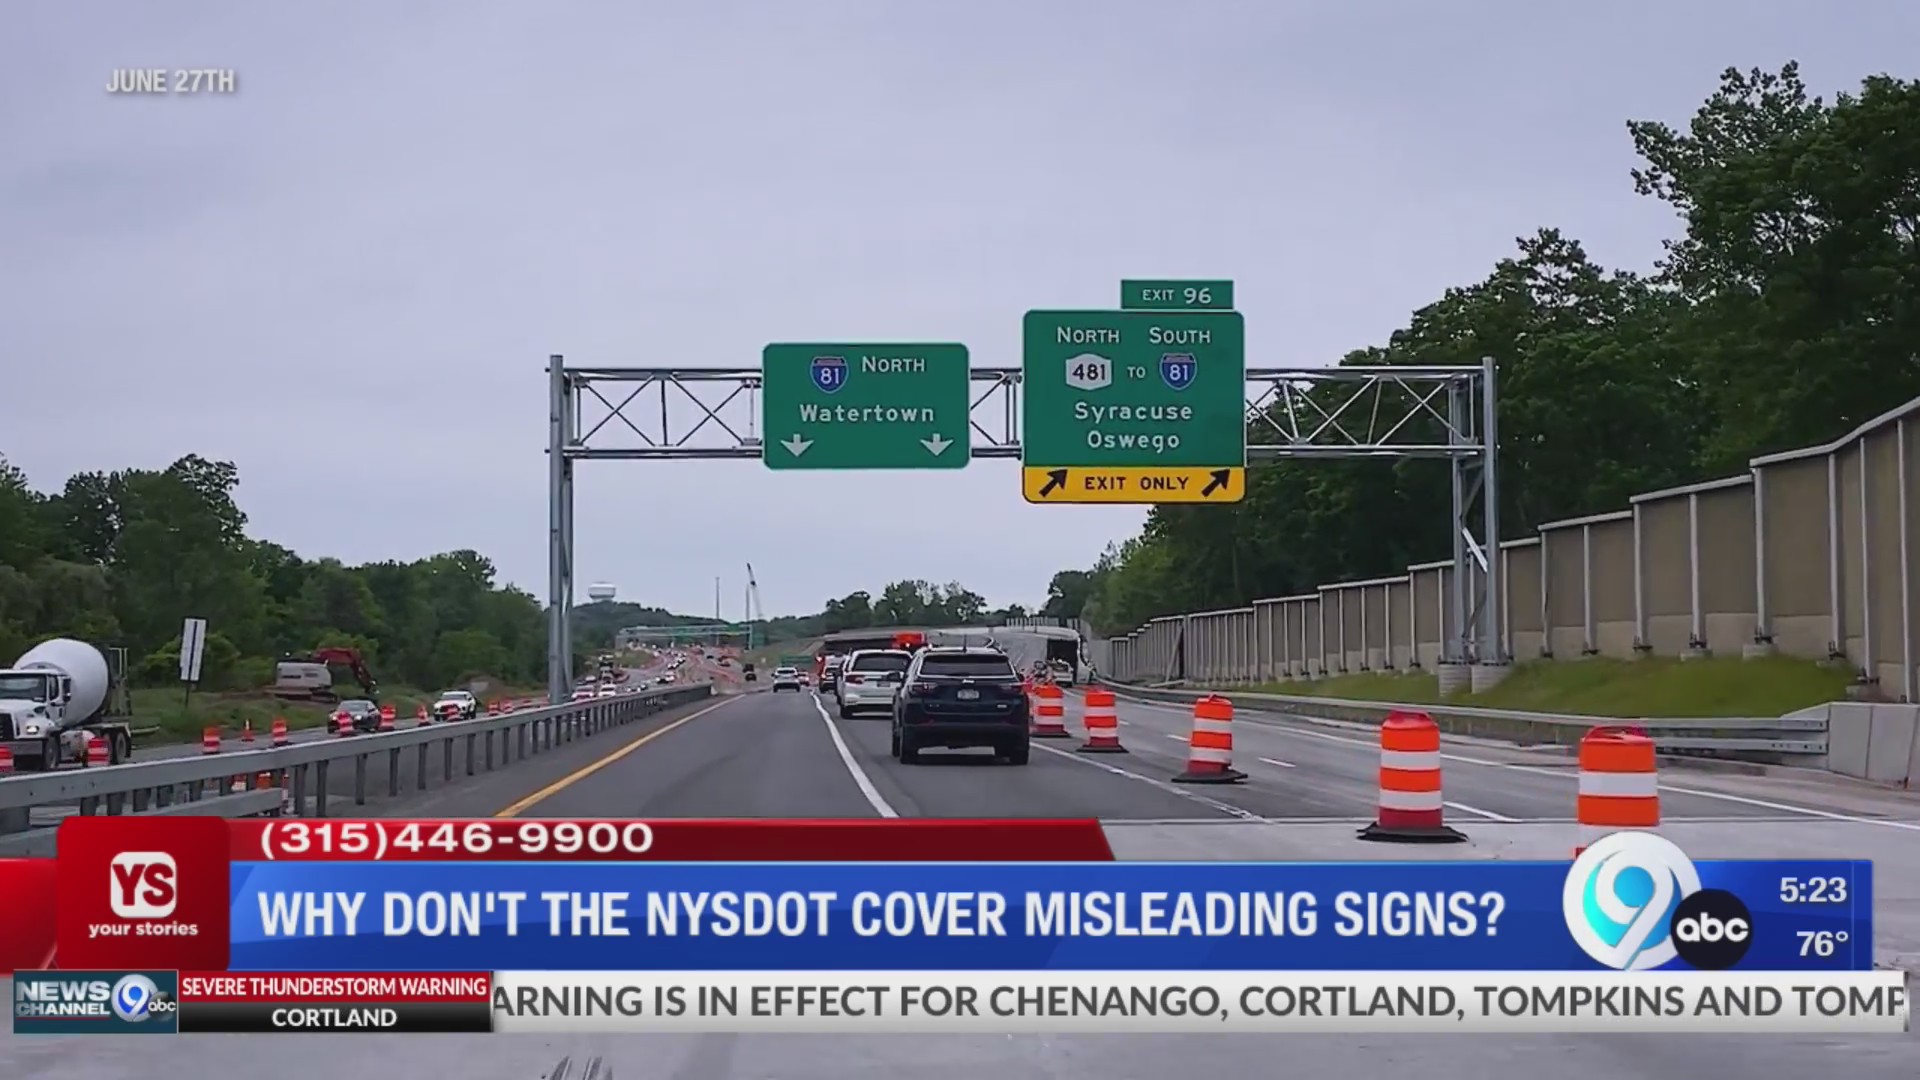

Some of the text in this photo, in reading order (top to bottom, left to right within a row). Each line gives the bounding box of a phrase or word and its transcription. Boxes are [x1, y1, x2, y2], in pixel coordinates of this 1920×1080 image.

[1142, 287, 1212, 304] EXIT 96
[1056, 326, 1212, 344] NORTH SOUTH
[820, 367, 840, 384] 81
[861, 355, 926, 372] NORTH
[1072, 363, 1189, 381] 481 TO 81
[800, 404, 935, 421] Watertown
[1075, 401, 1193, 424] Syracuse
[1087, 430, 1181, 453] Oswego
[1084, 476, 1190, 490] EXIT ONLY
